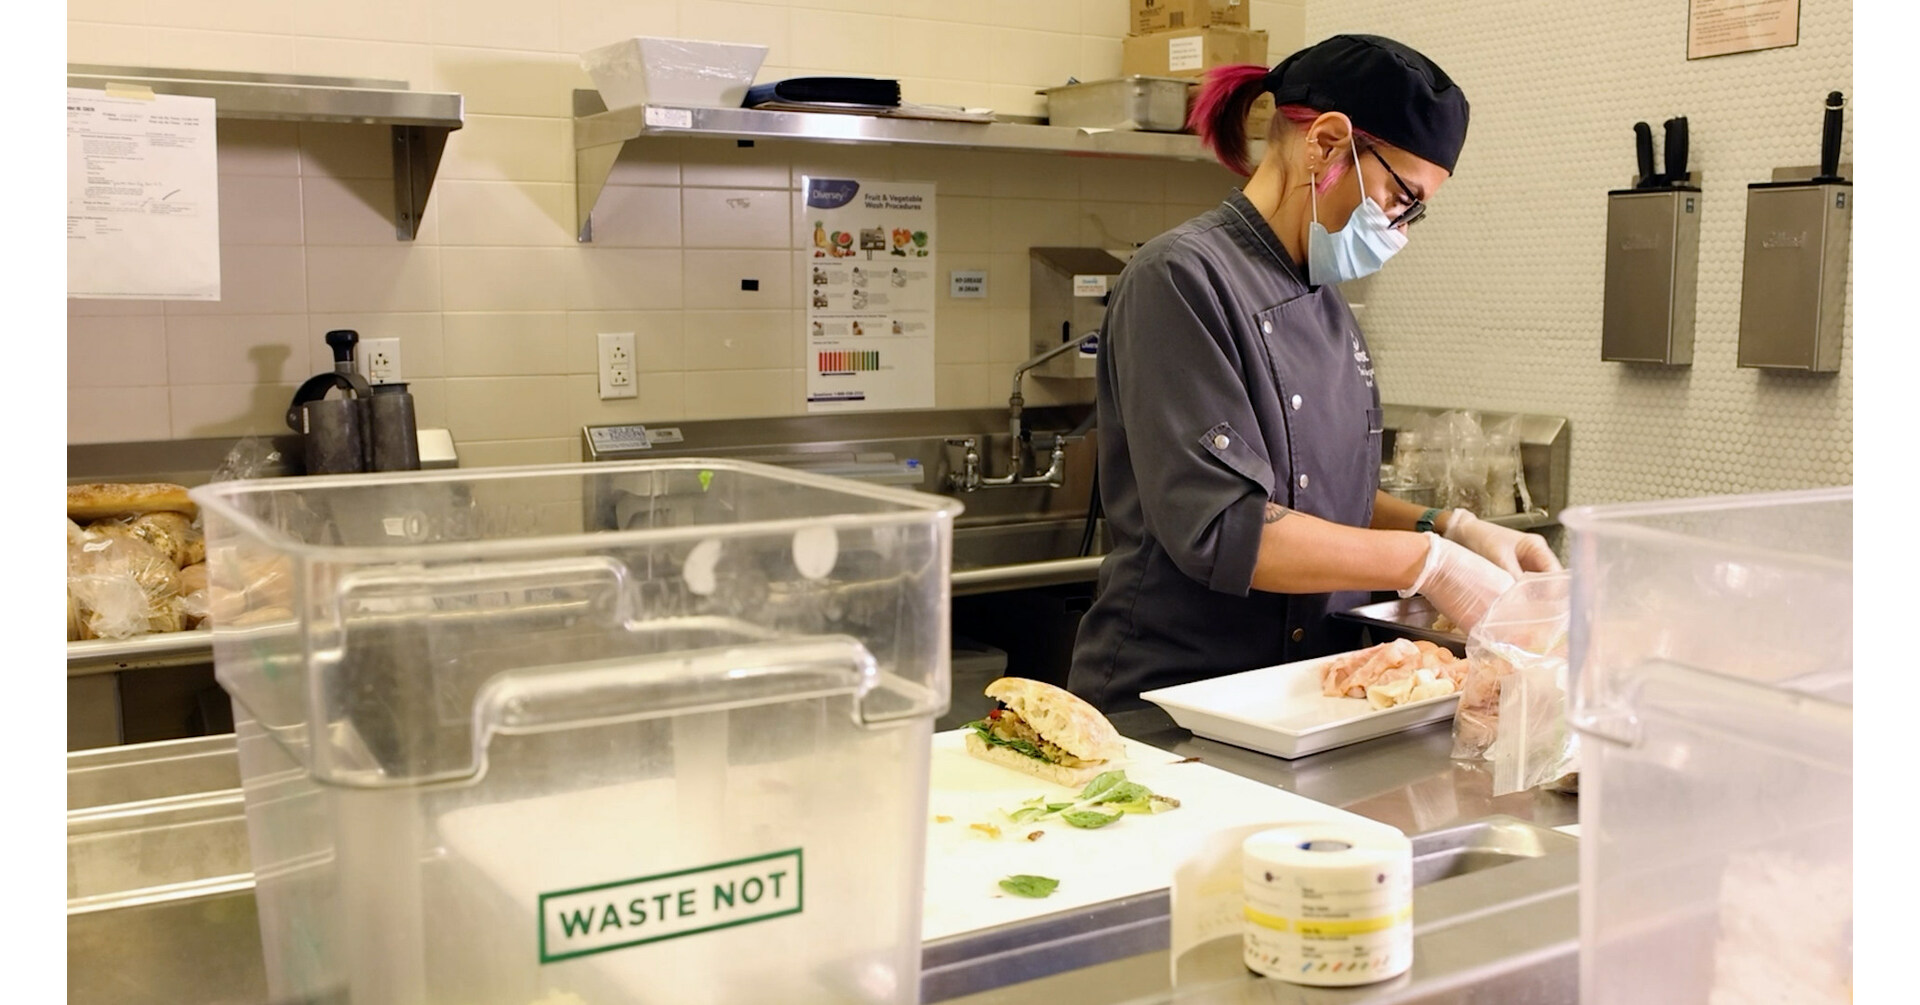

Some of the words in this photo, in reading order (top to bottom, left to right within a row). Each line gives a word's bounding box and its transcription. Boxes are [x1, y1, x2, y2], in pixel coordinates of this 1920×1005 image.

[813, 189, 844, 200] Diversey
[865, 193, 881, 201] Fruit
[889, 194, 923, 203] Vegetable
[885, 202, 922, 210] Procedures
[560, 889, 697, 939] WASTE
[713, 871, 787, 911] NOT
